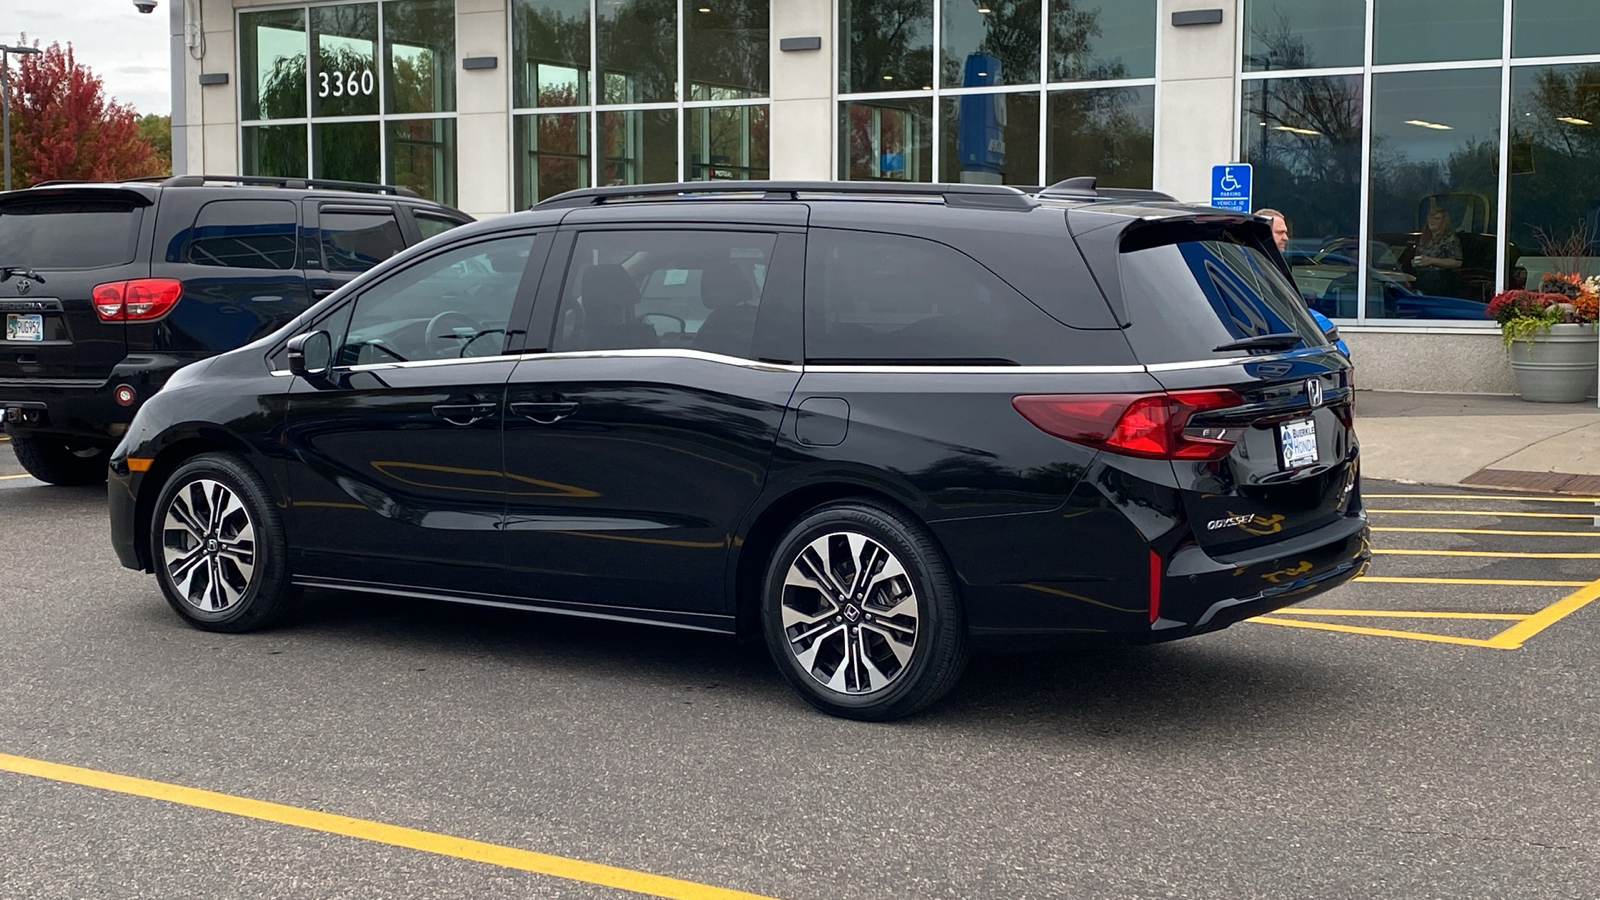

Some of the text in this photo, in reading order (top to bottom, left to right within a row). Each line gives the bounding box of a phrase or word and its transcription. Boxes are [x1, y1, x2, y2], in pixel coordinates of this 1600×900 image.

[318, 69, 374, 97] 3360
[1294, 438, 1317, 455] HONDA
[1207, 513, 1255, 531] ODYSSEY
